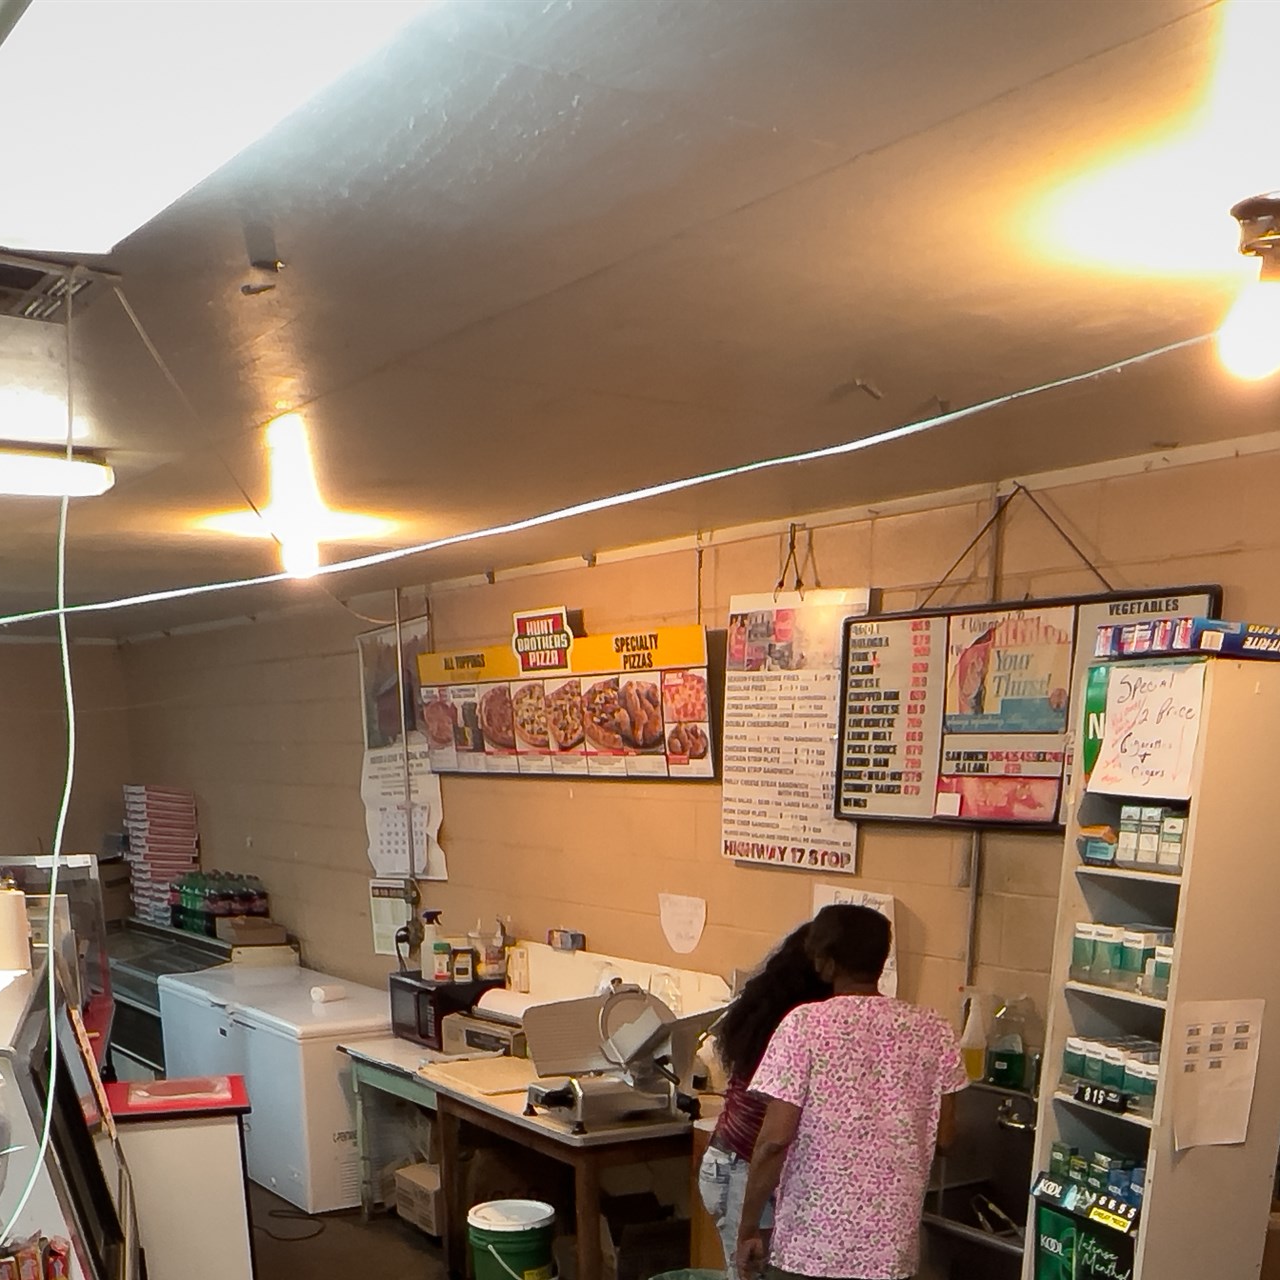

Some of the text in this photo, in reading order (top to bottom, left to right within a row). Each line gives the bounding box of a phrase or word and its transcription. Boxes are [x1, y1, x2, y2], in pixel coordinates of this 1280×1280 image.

[1108, 599, 1180, 616] VEGETABLES
[525, 618, 555, 635] HUNT
[516, 634, 569, 651] BROTHERS
[614, 634, 659, 653] SPECIALTY
[528, 651, 559, 667] PIZZA
[623, 654, 654, 669] PIZZAS
[723, 840, 852, 868] HIGHWAY 17 STOP
[1039, 1178, 1063, 1198] KOOL
[1040, 1233, 1065, 1257] KOOL
